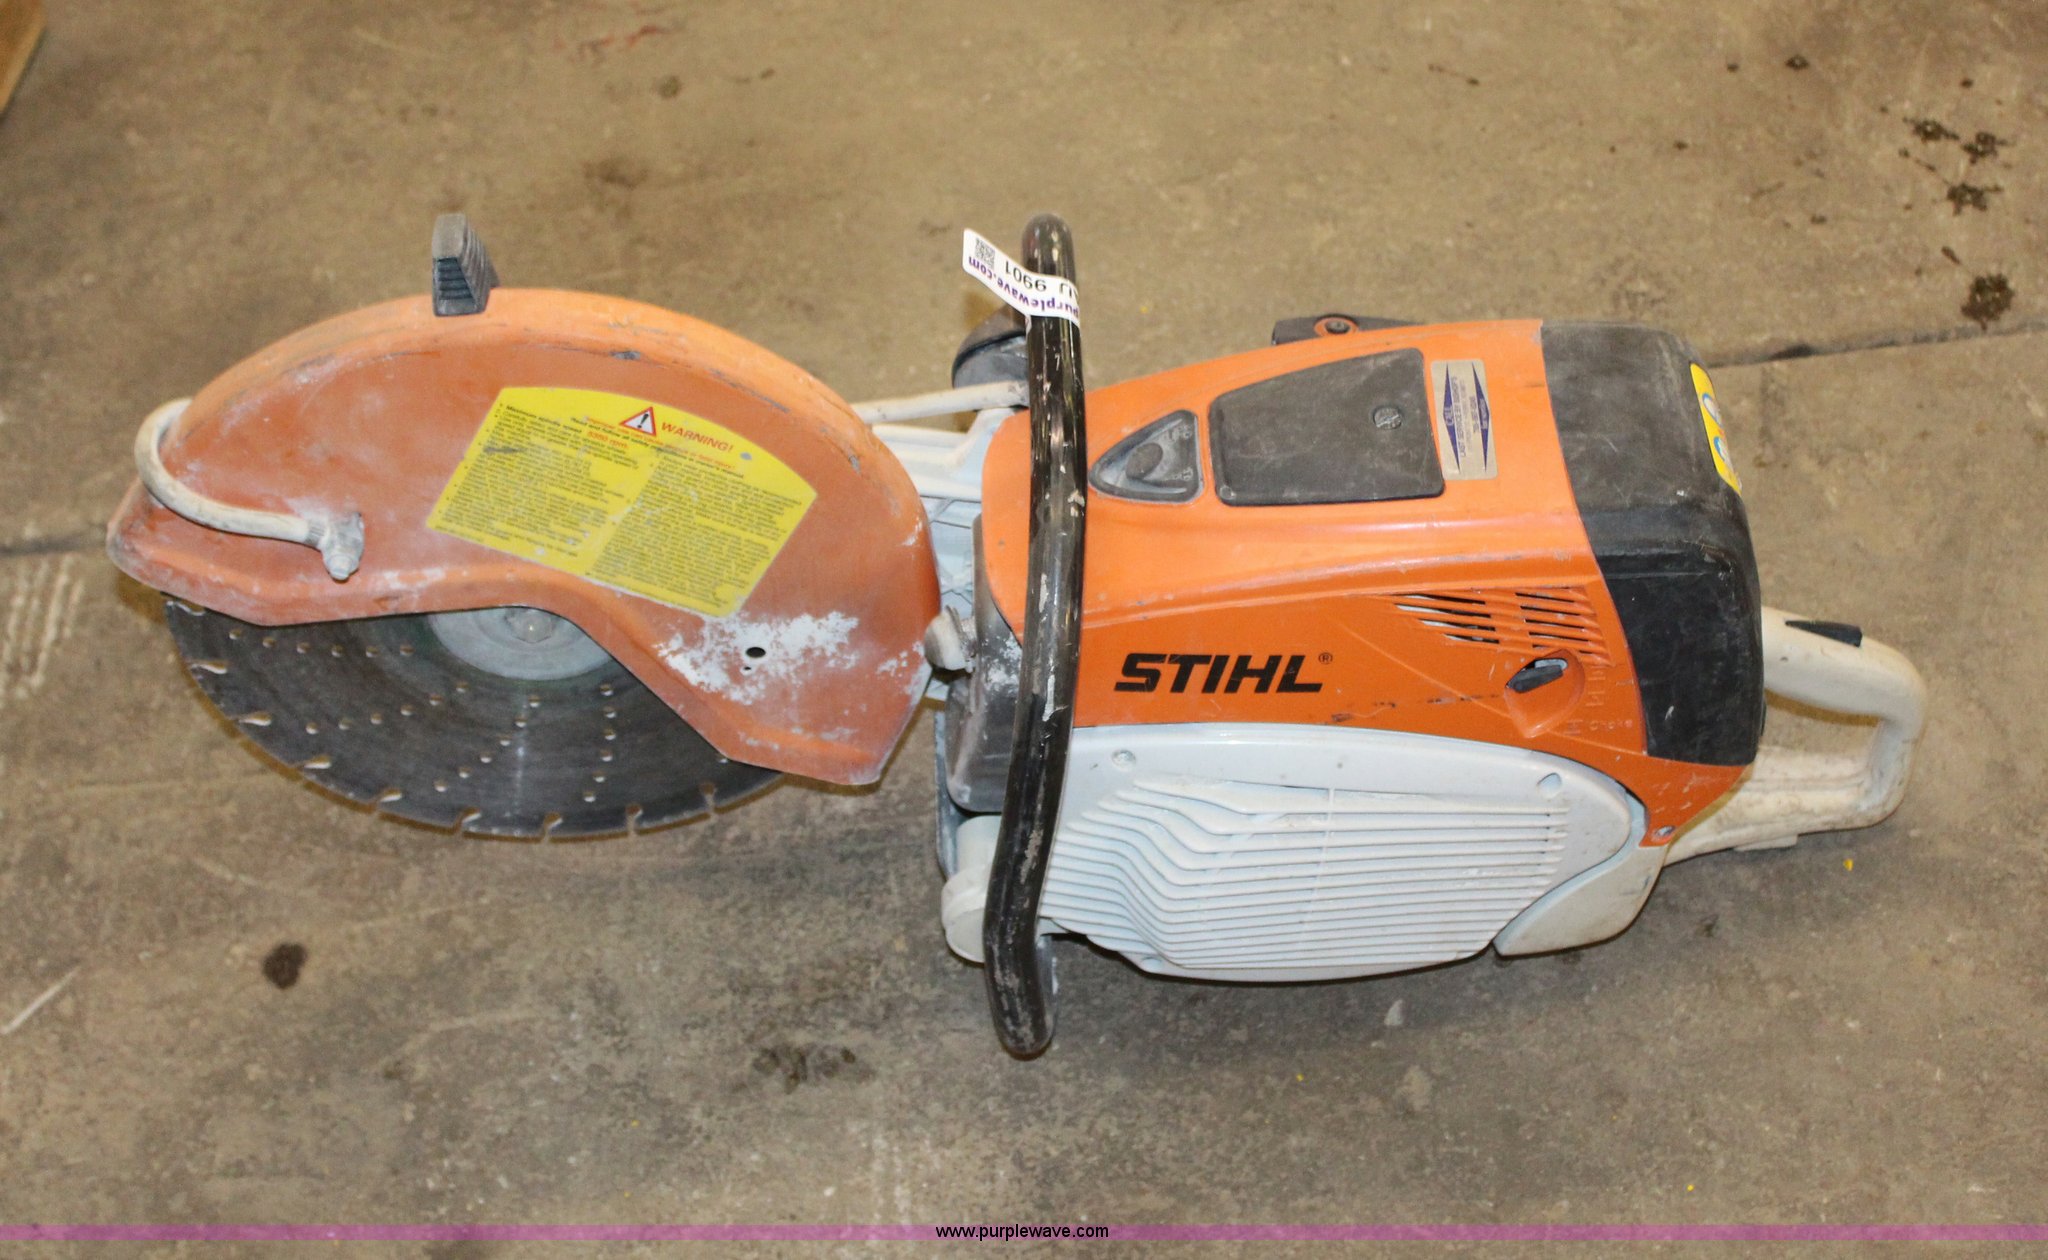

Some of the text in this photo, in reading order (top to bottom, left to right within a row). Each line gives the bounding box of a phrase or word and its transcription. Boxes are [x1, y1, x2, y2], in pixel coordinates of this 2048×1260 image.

[968, 255, 1079, 316] purplewave.com
[1005, 260, 1047, 292] 9901
[661, 421, 735, 452] WARNING!
[1114, 653, 1323, 693] STIHL
